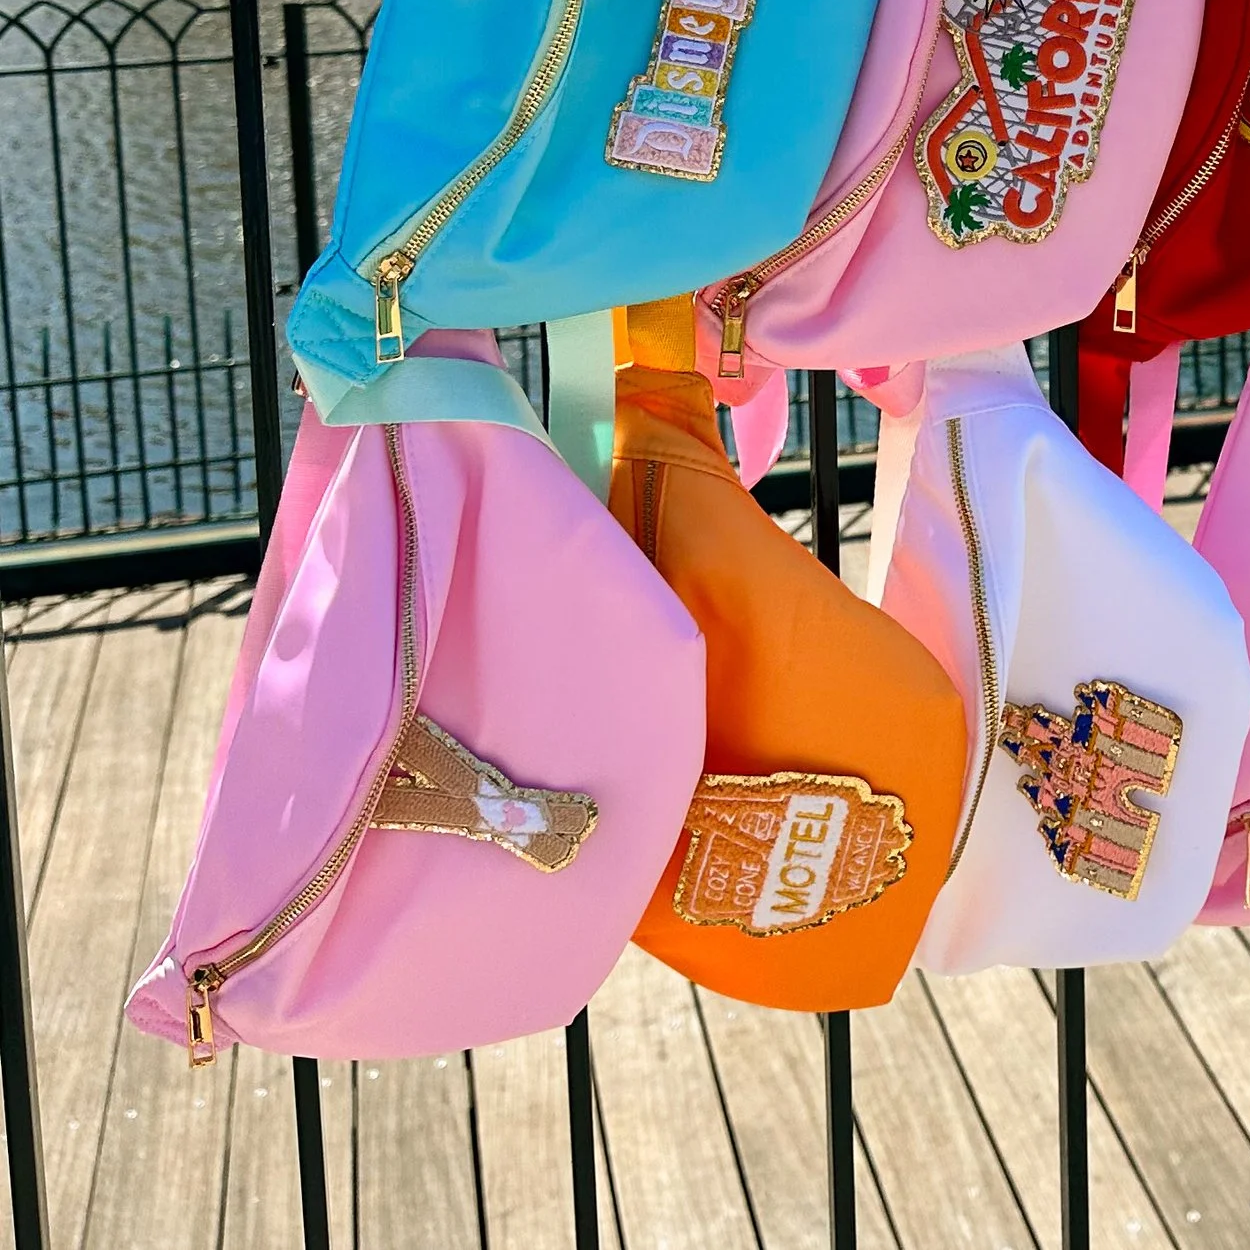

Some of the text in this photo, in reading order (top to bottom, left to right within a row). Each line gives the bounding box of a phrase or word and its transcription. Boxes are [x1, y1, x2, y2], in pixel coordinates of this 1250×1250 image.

[704, 854, 730, 901] COZY
[733, 860, 761, 907] CONE
[770, 802, 834, 915] MOTEL
[849, 824, 875, 891] VACANCY
